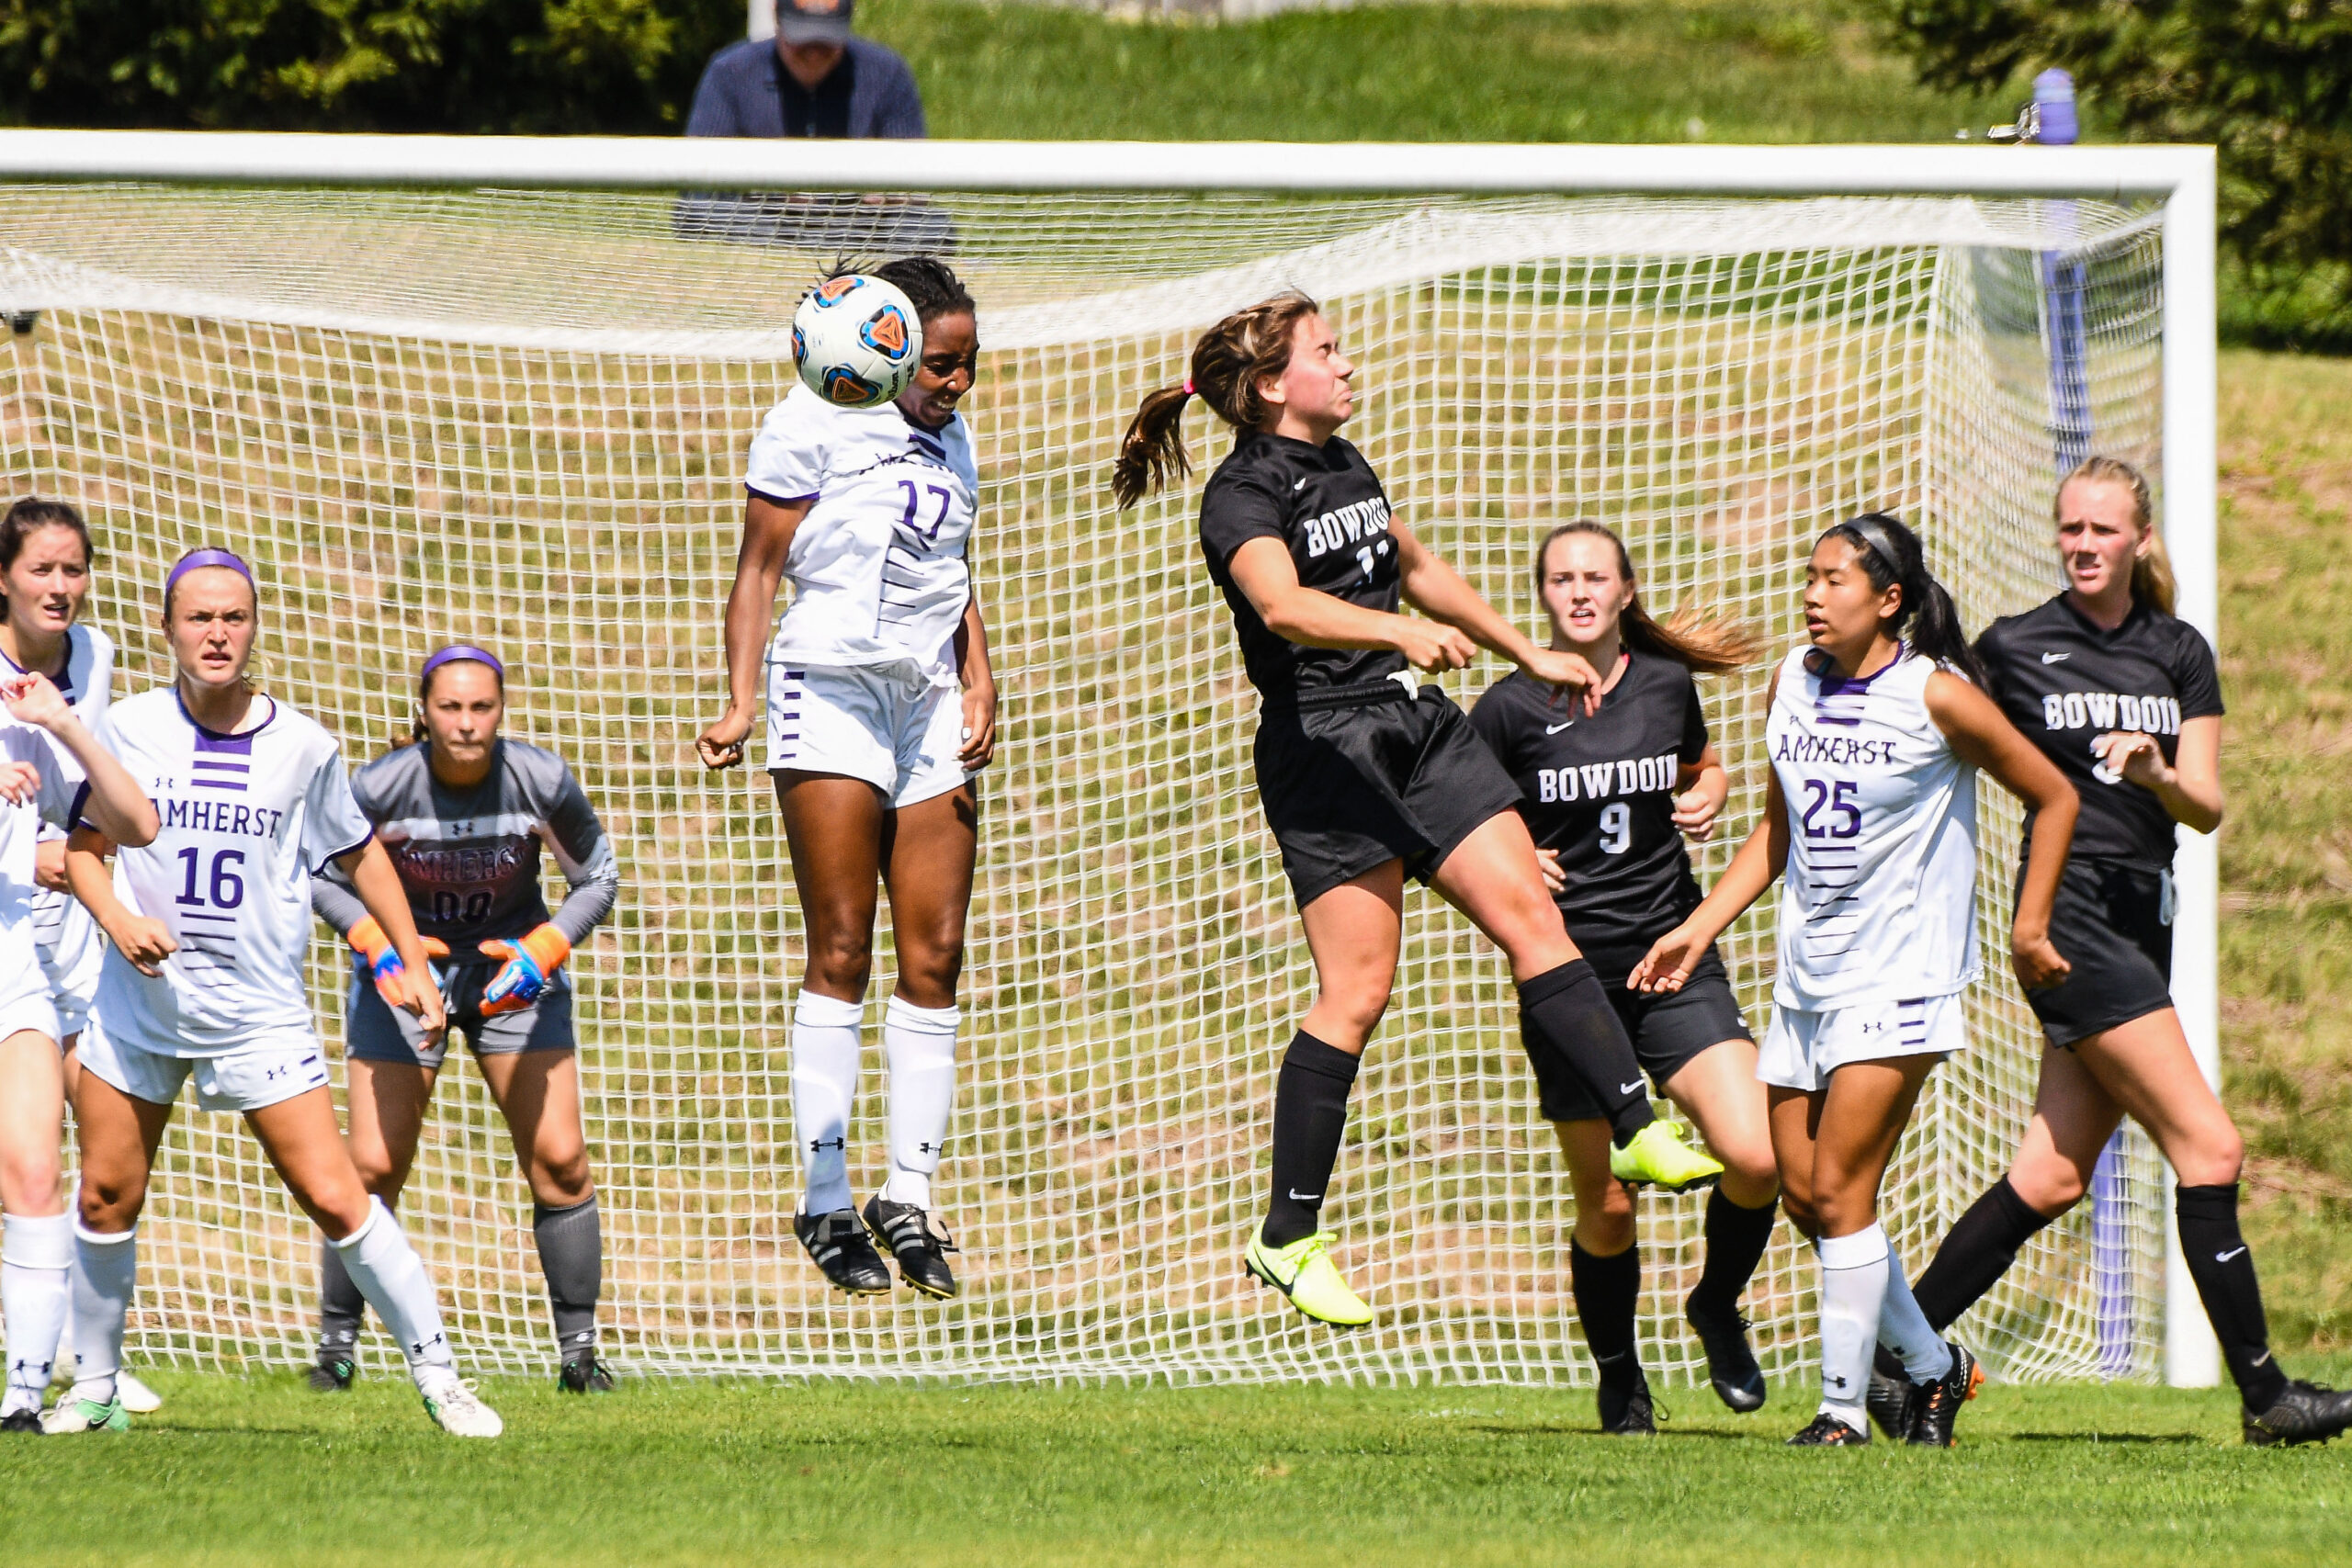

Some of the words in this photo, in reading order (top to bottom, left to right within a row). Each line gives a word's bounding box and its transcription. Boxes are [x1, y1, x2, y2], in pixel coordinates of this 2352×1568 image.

[897, 480, 951, 541] 17
[1303, 496, 1390, 558] BOWDO
[1775, 734, 1897, 764] AMHERST
[1599, 801, 1632, 854] 9
[1802, 779, 1862, 839] 25
[175, 846, 246, 909] 16
